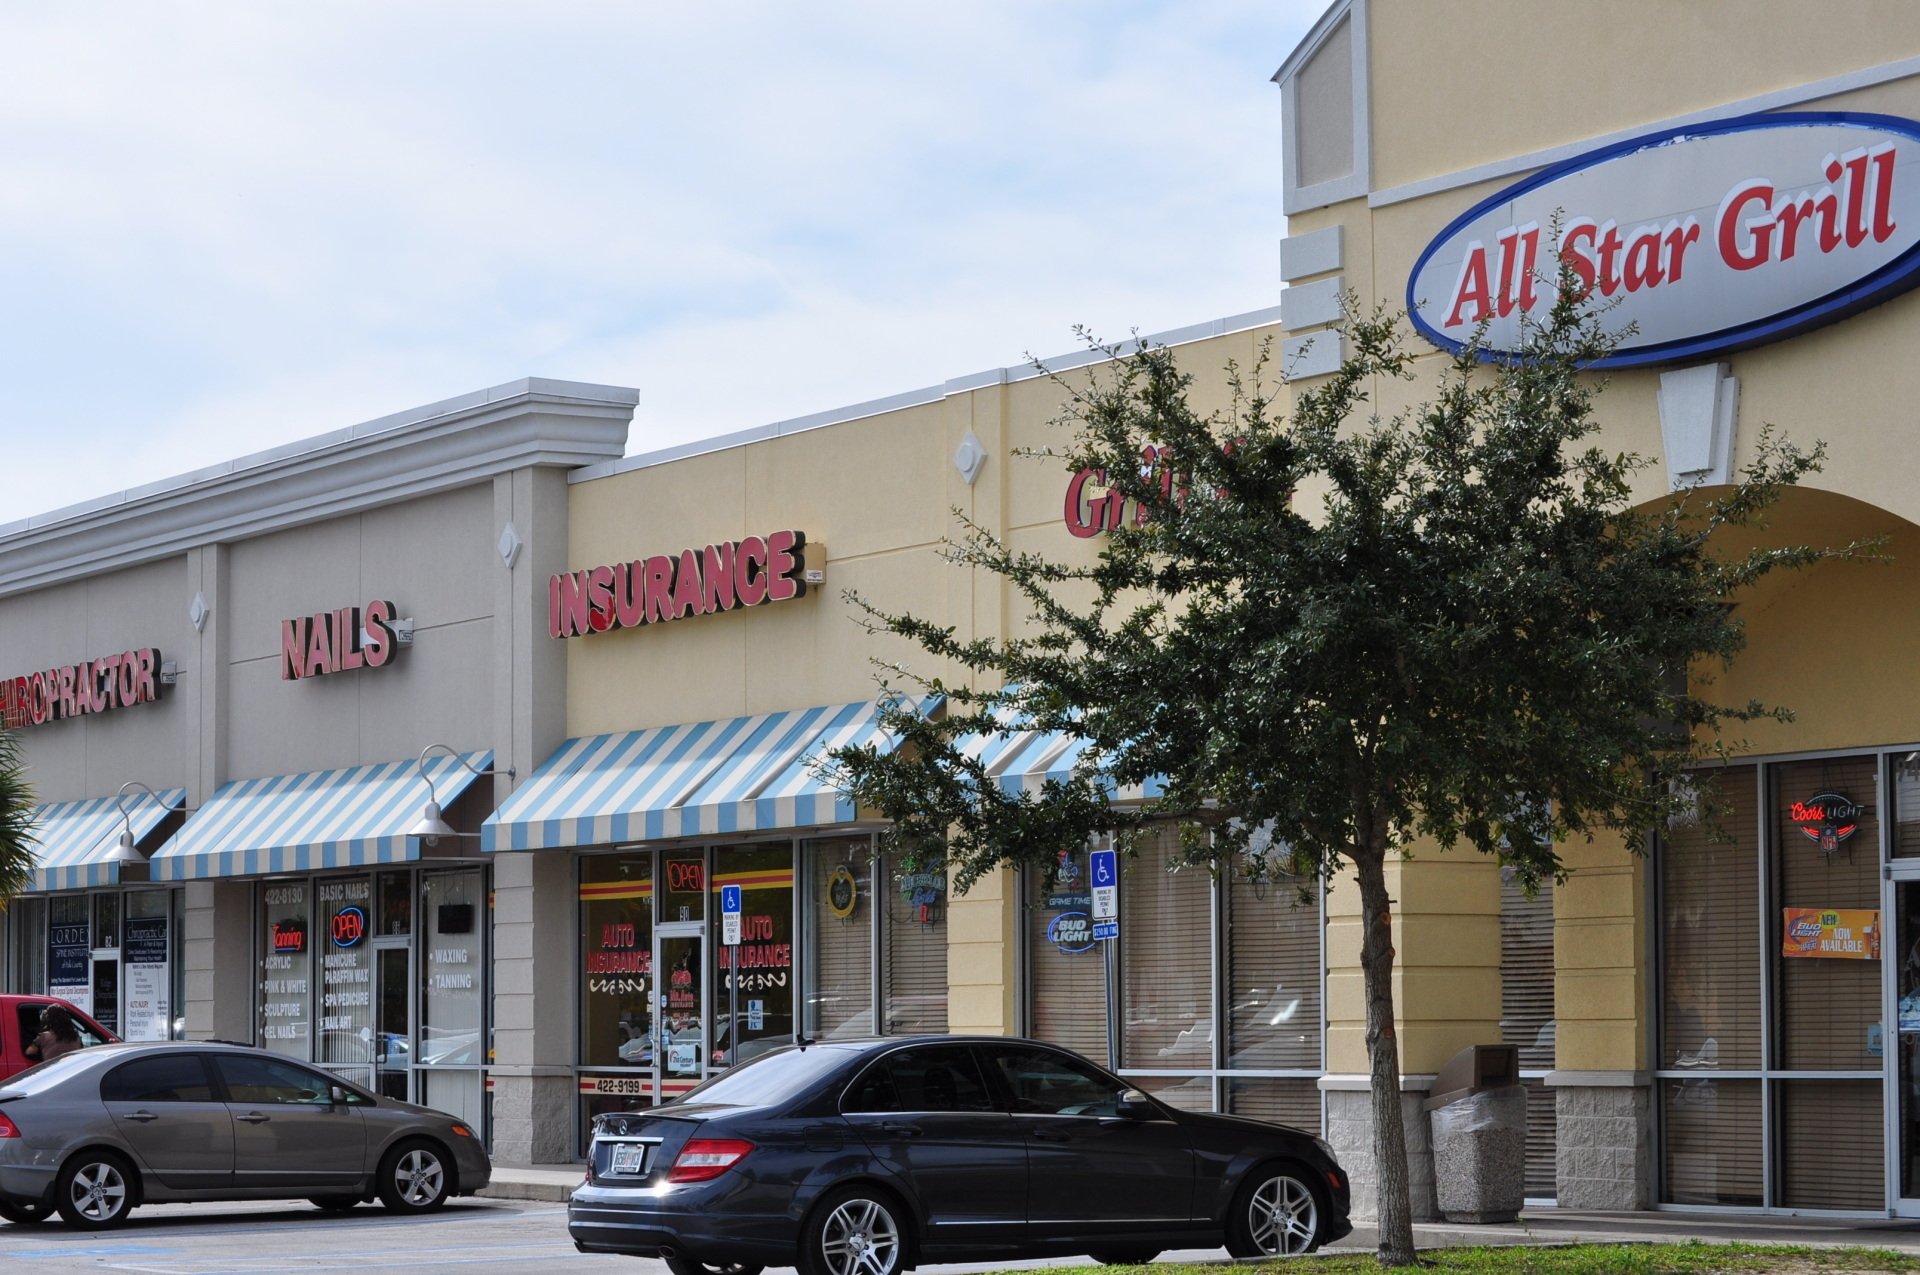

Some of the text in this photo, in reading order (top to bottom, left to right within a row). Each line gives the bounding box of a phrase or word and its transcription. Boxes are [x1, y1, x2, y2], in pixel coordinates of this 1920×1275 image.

[1444, 148, 1897, 329] All Star Grill
[549, 529, 799, 639] INSURANCE
[281, 599, 392, 680] NAILS
[1791, 802, 1864, 820] Coors LIGHT
[669, 863, 704, 889] OPEN
[265, 888, 302, 904] 422-8130
[320, 882, 369, 901] BASIC NAILS
[1049, 897, 1071, 906] GAME
[680, 906, 689, 921] 90
[1821, 914, 1838, 926] NEW
[332, 914, 362, 939] OPEN
[740, 915, 773, 940] AUTO
[1058, 920, 1087, 931] BUD
[1797, 922, 1822, 930] BUD
[272, 924, 302, 951] Tanning
[601, 923, 635, 948] AUTO
[1054, 930, 1092, 942] LIGHT
[1833, 928, 1852, 939] NOW
[1820, 939, 1863, 953] AVAILABLE
[265, 956, 291, 969] ACRYLIC
[325, 954, 356, 968] MANICURE
[435, 949, 467, 964] WAXING
[586, 951, 651, 974] INSURANCE
[325, 969, 369, 984] PARAFFIN WAX
[435, 974, 472, 989] TANNING
[264, 980, 307, 993] PINK & WHITE
[325, 992, 369, 1007] SPA PEDICURE
[264, 1003, 300, 1017] SCULPTURE
[324, 1016, 352, 1029] NAIL ART
[264, 1026, 296, 1038] GEL NAILS
[596, 1079, 640, 1093] 422-9199
